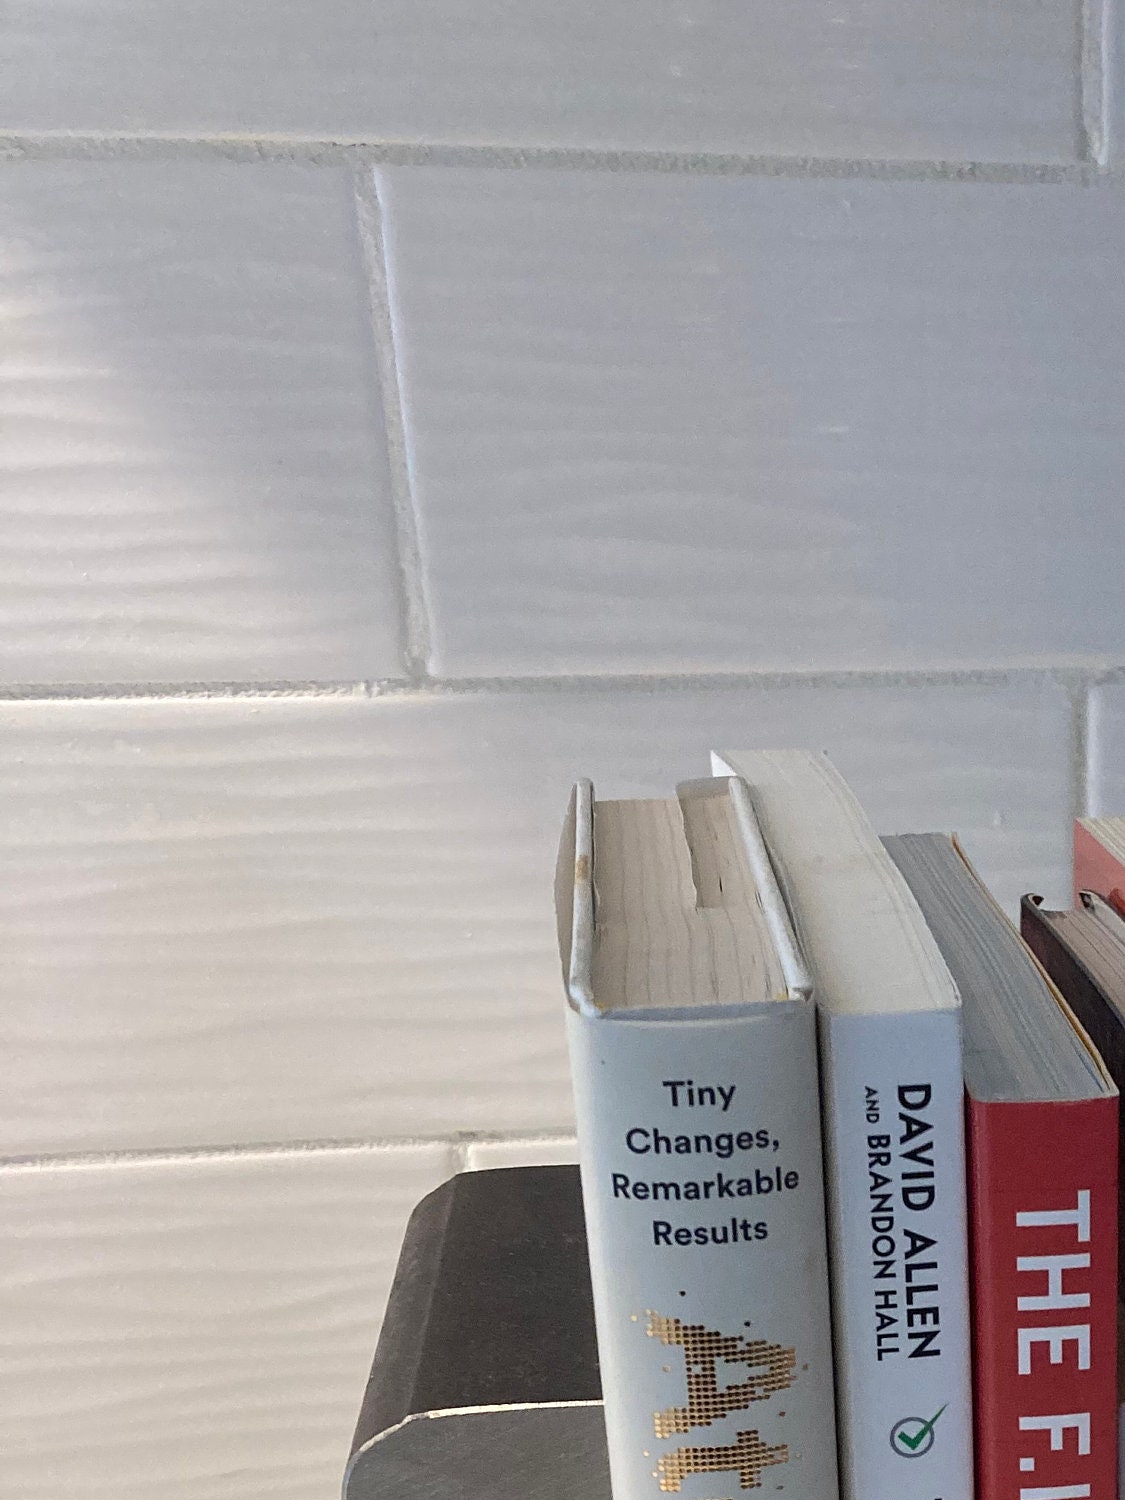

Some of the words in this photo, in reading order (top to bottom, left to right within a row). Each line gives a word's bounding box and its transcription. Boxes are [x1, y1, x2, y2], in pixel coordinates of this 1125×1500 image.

[663, 1080, 737, 1112] Tiny
[864, 1085, 880, 1124] AND
[625, 1129, 781, 1160] Changes,
[897, 1084, 936, 1212] DAVID
[611, 1166, 801, 1201] Remarkable
[867, 1134, 896, 1280] BRANDON
[652, 1217, 769, 1247] Results
[903, 1228, 942, 1359] ALLEN
[1016, 1190, 1091, 1375] THE
[874, 1290, 900, 1362] HALL
